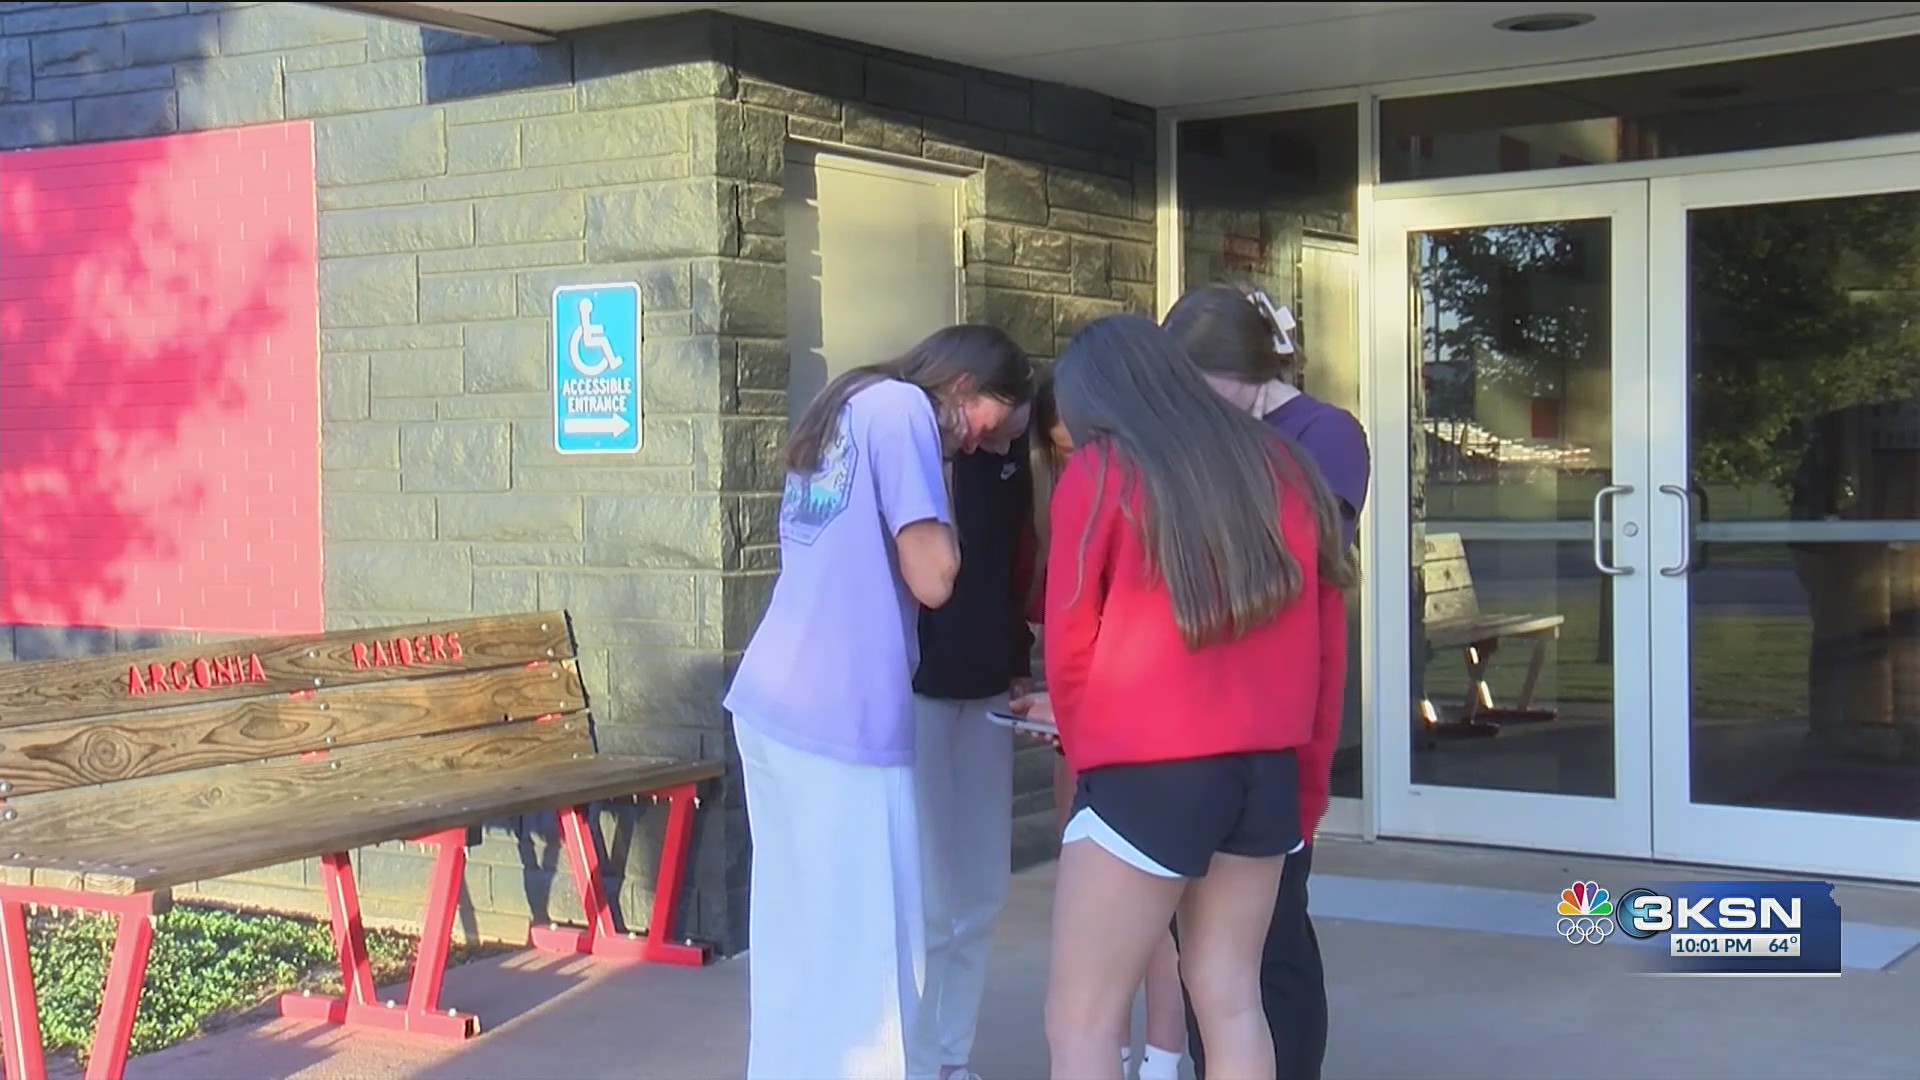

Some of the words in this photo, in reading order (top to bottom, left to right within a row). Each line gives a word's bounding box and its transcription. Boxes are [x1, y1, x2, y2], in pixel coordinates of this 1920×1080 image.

[562, 377, 632, 396] ACCESSIBLE
[568, 395, 627, 413] ENTRANCE
[128, 653, 266, 695] ARGONIA
[352, 632, 463, 670] RAIDERS
